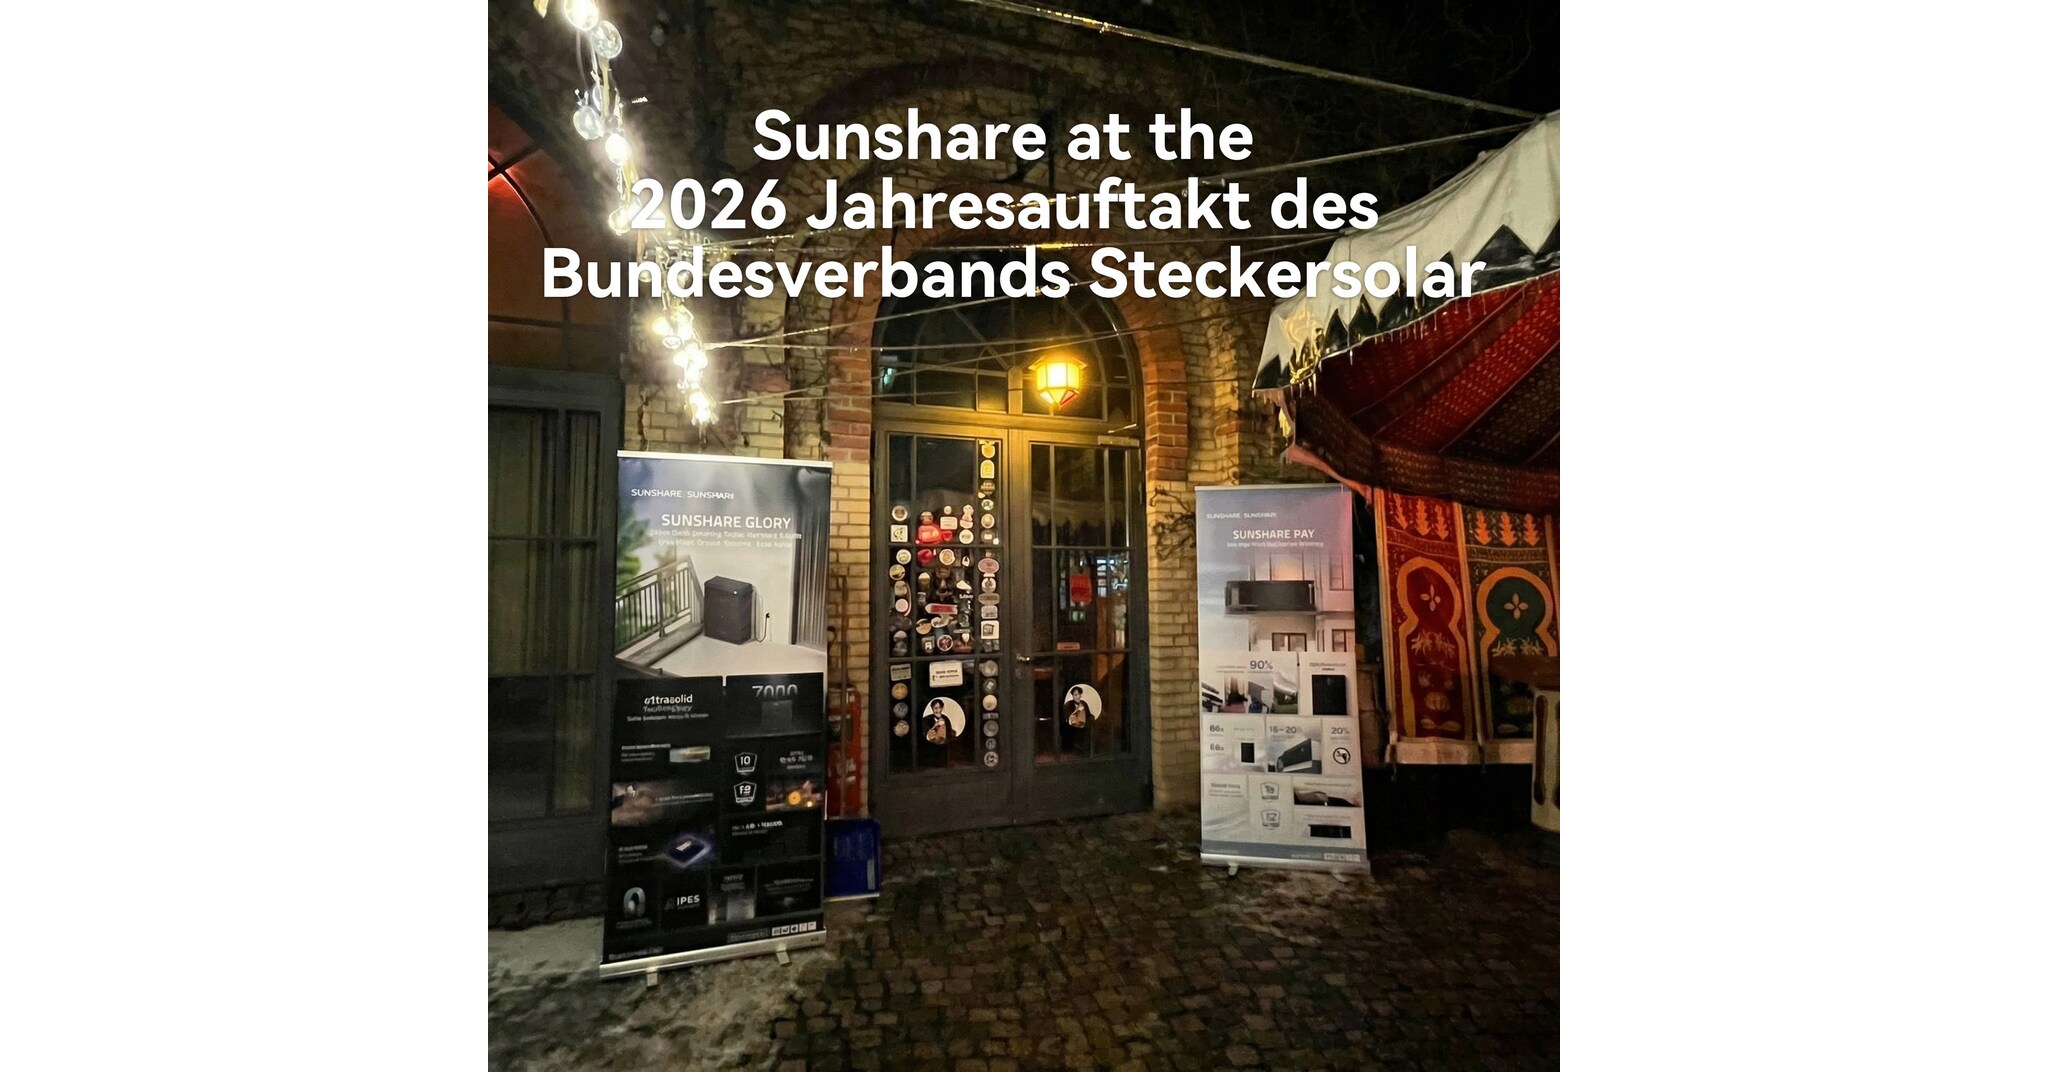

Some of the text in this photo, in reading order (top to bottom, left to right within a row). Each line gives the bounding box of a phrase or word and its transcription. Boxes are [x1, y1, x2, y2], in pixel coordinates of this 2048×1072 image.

[631, 488, 683, 498] SUNSHARE
[661, 513, 792, 529] SUNSHARE GLORY
[1232, 529, 1316, 540] SUNSHARE PAY
[1249, 660, 1274, 670] 90%
